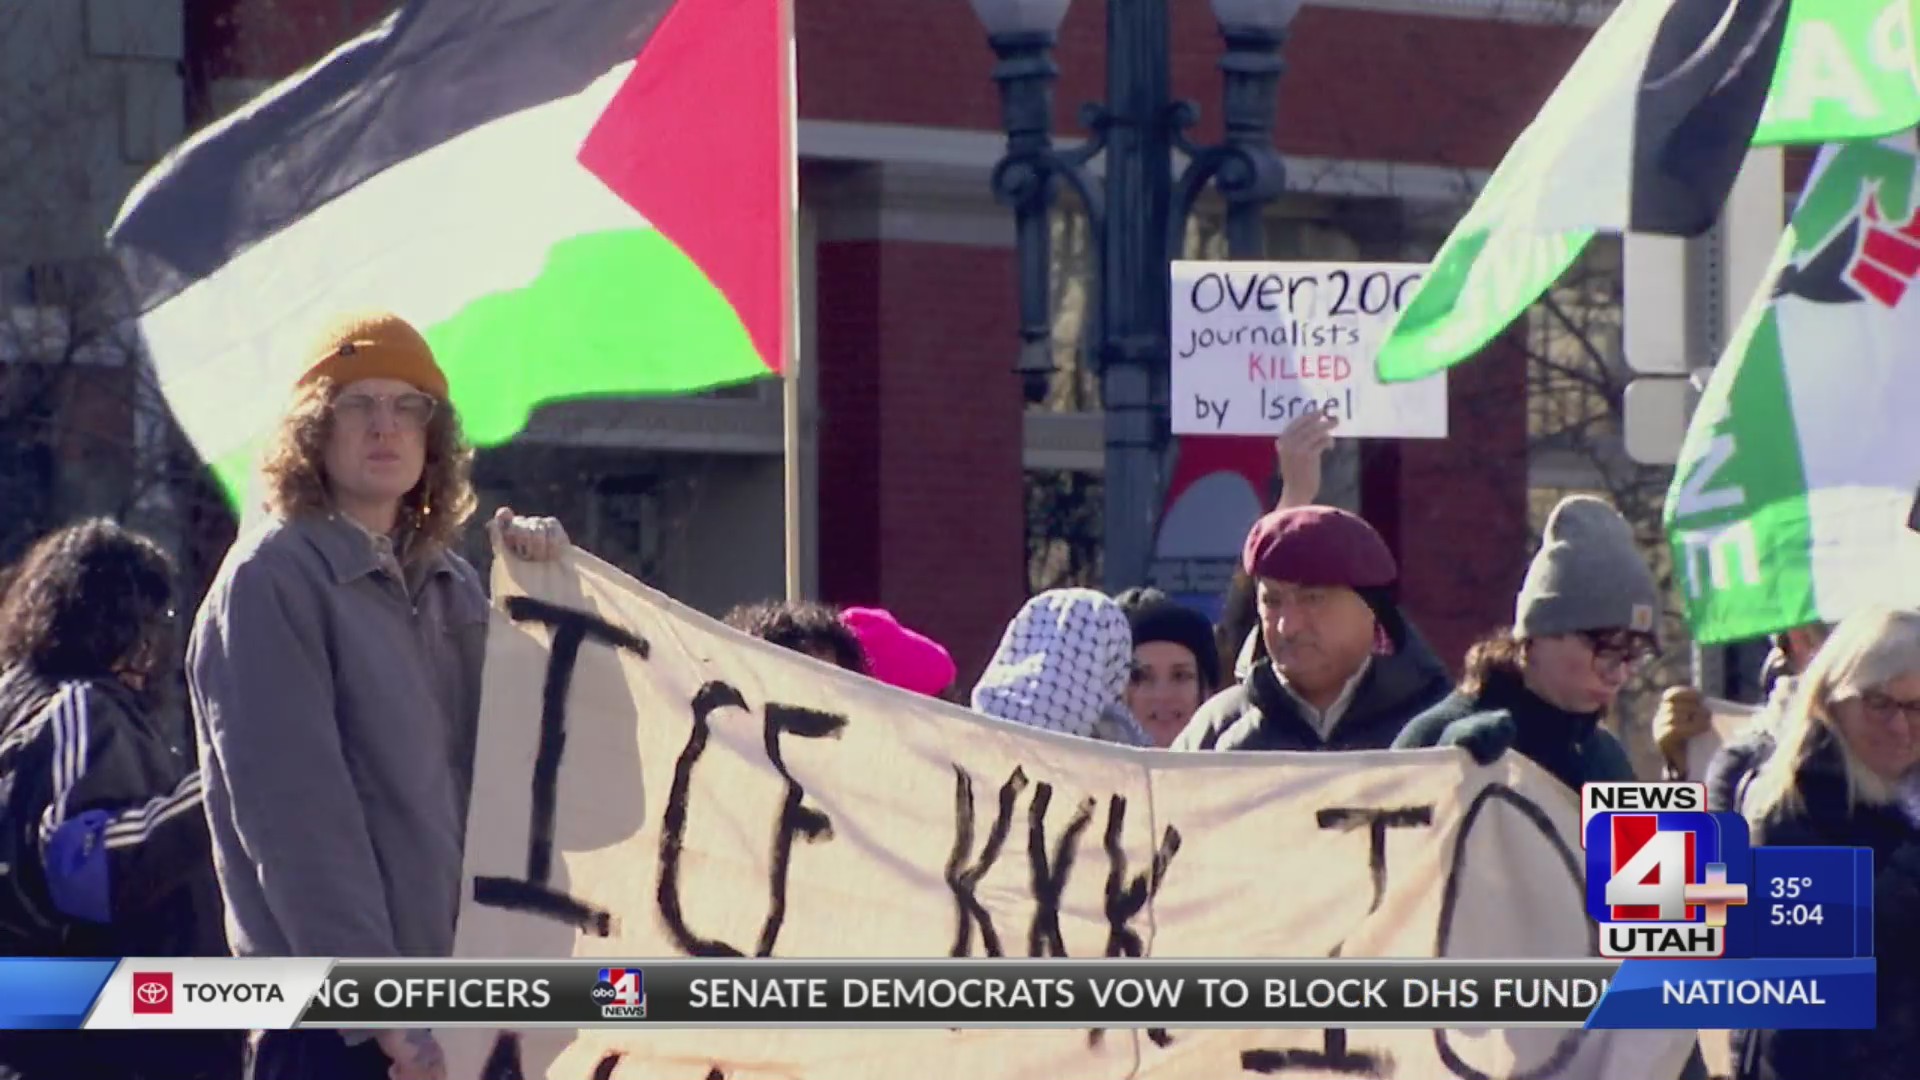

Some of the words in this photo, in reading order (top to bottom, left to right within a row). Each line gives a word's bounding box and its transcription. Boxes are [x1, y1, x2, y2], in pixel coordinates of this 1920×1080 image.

[1179, 320, 1360, 359] journalists
[1248, 354, 1351, 382] KILLED
[1195, 393, 1229, 428] by
[1260, 387, 1352, 421] Israel
